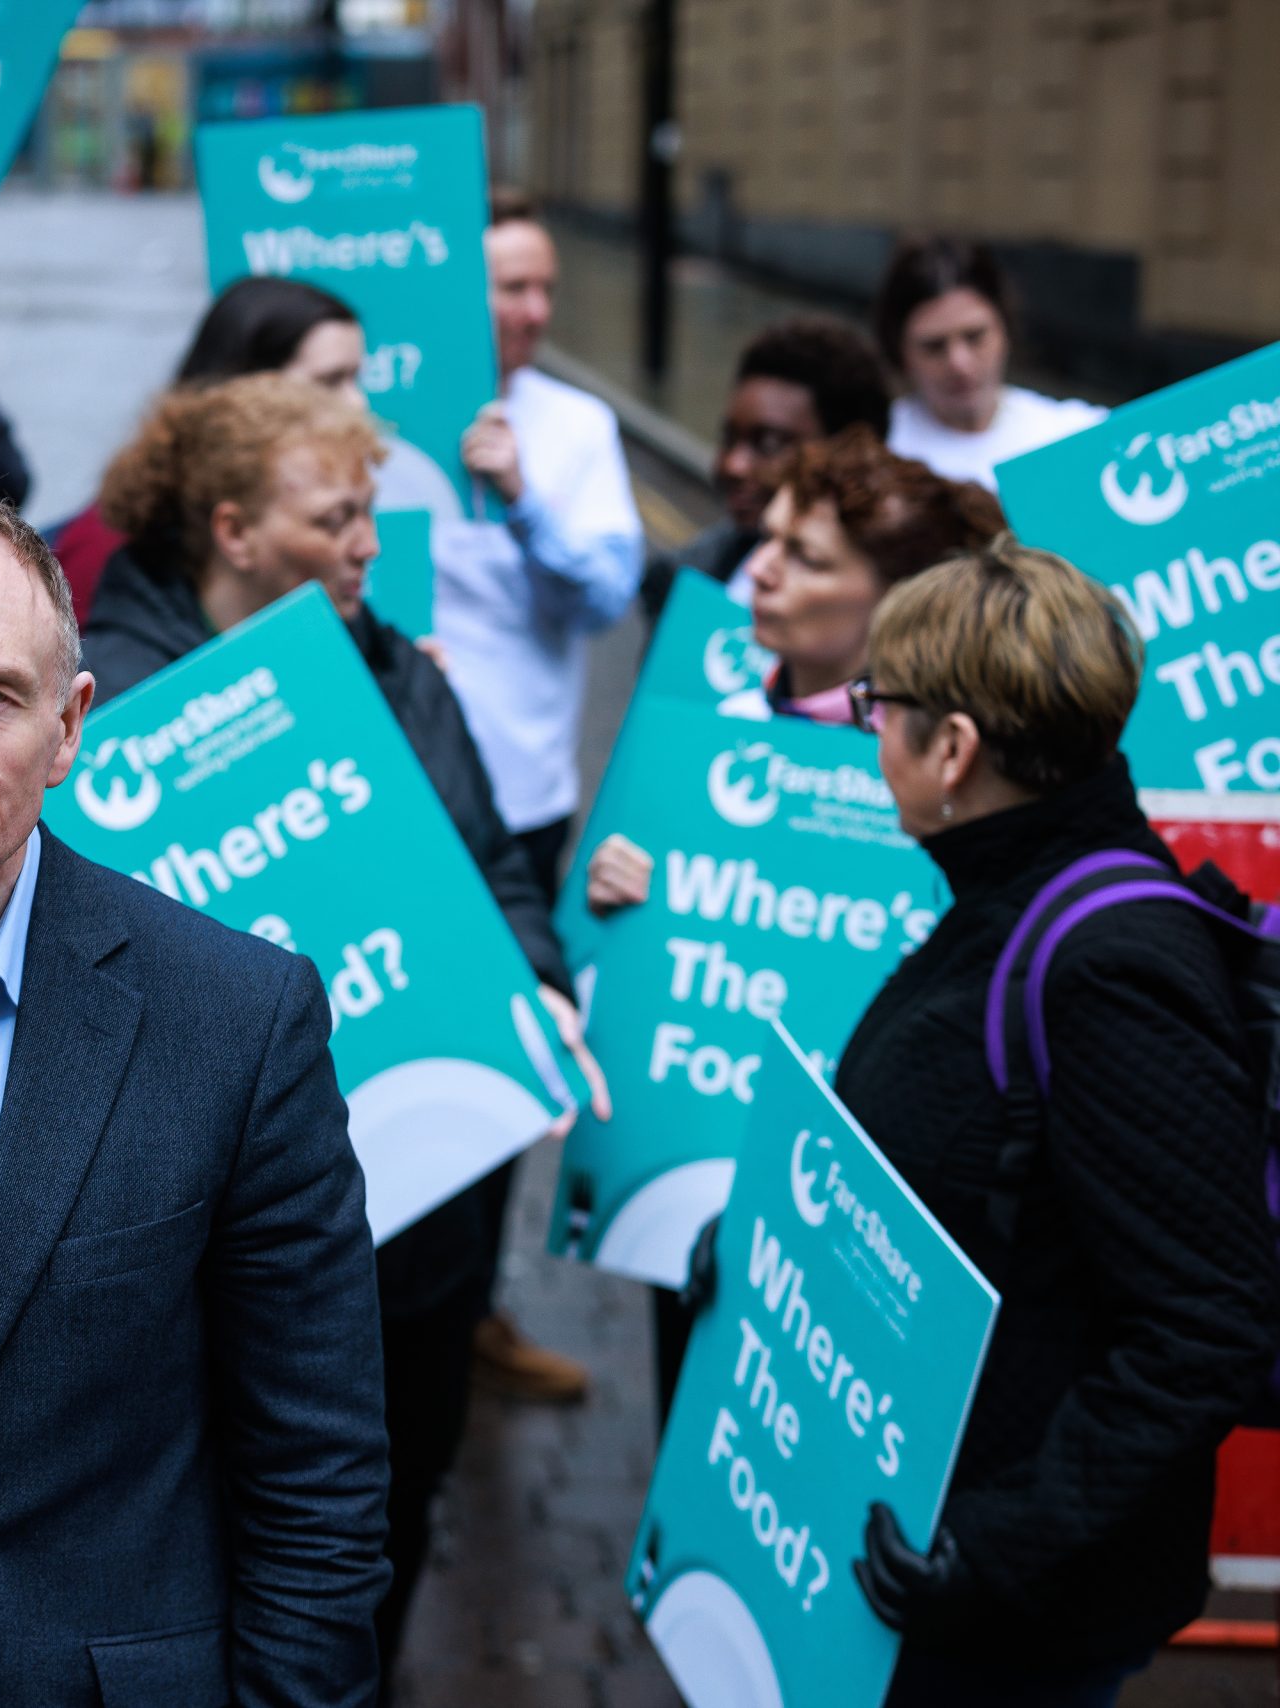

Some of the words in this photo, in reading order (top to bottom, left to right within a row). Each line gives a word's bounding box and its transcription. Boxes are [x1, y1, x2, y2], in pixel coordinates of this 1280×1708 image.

[243, 221, 449, 277] Where's
[666, 850, 936, 956] Where's
[666, 937, 789, 1021] The
[733, 1318, 800, 1459] The
[748, 1216, 905, 1478] Where's
[708, 1407, 830, 1611] Food?
